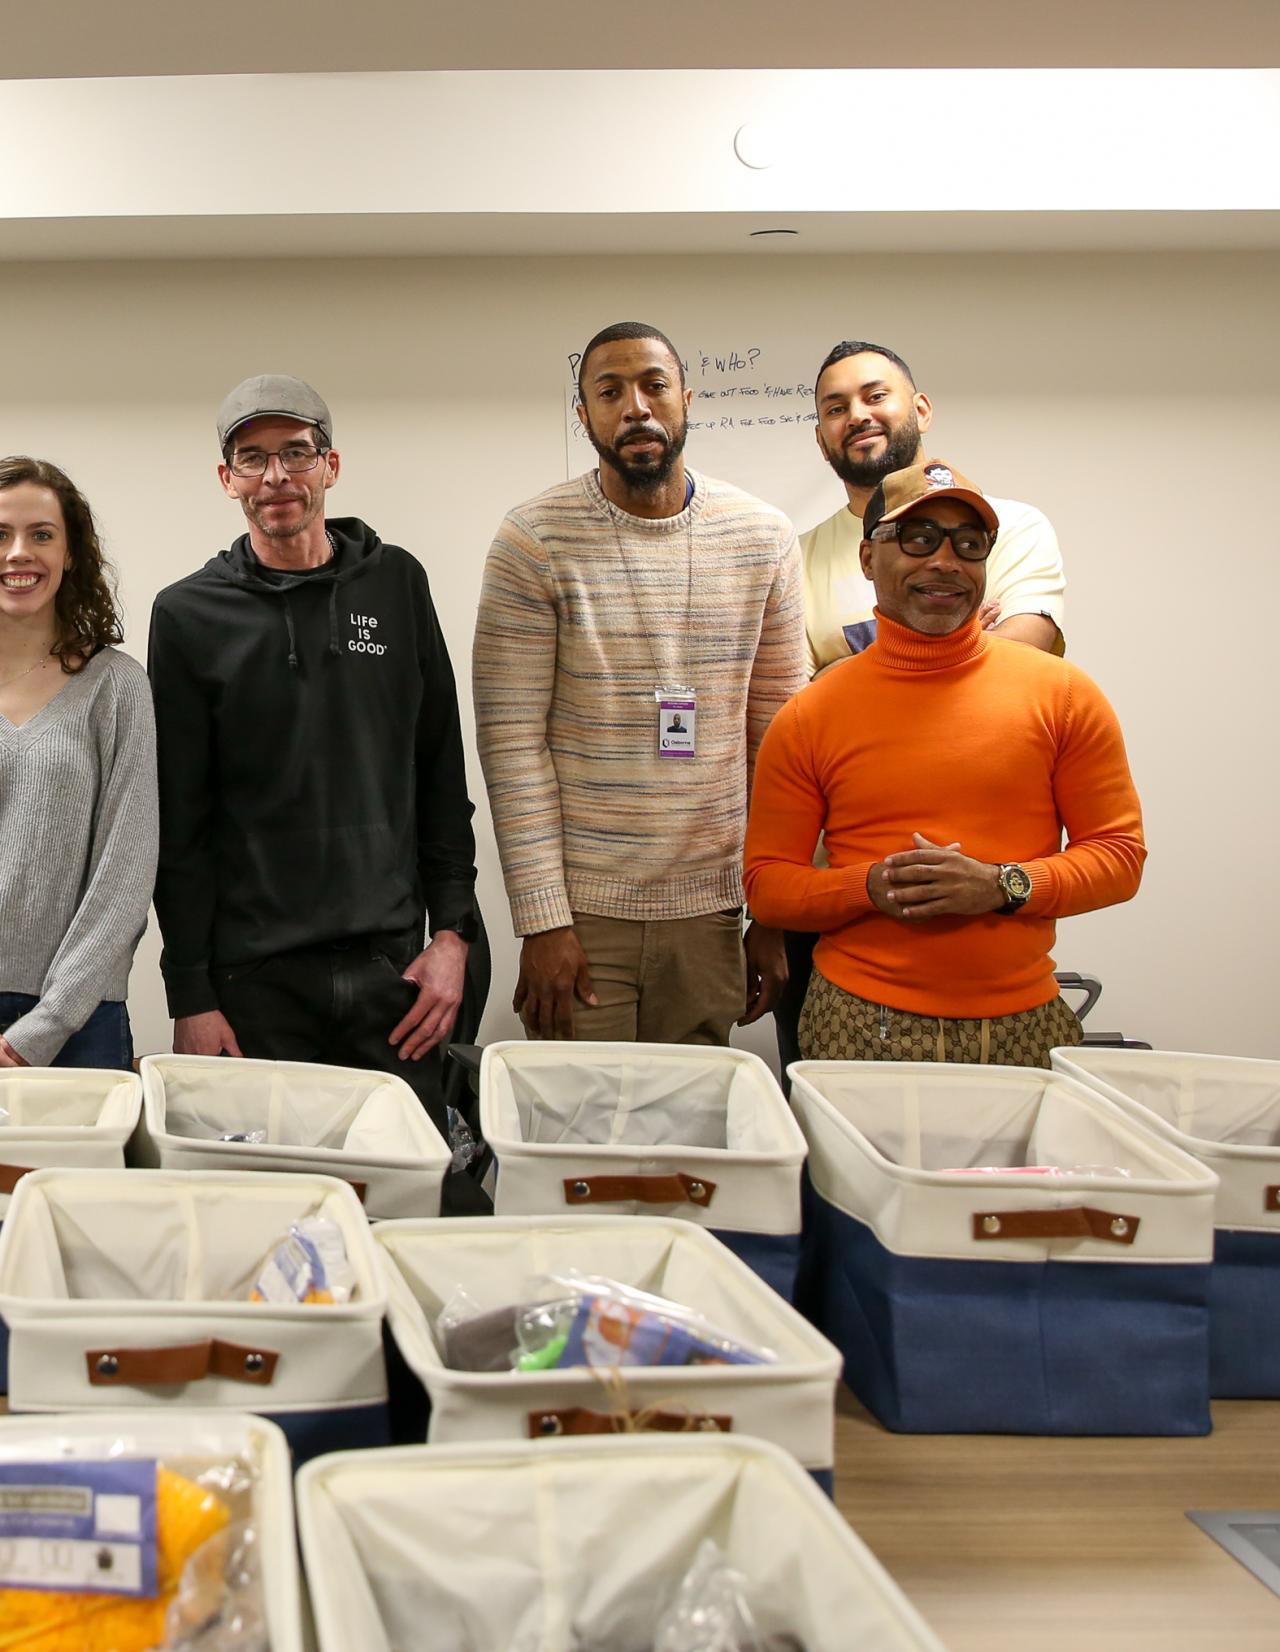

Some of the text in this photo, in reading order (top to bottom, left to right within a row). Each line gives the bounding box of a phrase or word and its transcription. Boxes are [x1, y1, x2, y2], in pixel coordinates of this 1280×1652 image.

[715, 348, 761, 373] WHO?
[739, 386, 759, 396] FOOD
[358, 628, 372, 641] IS
